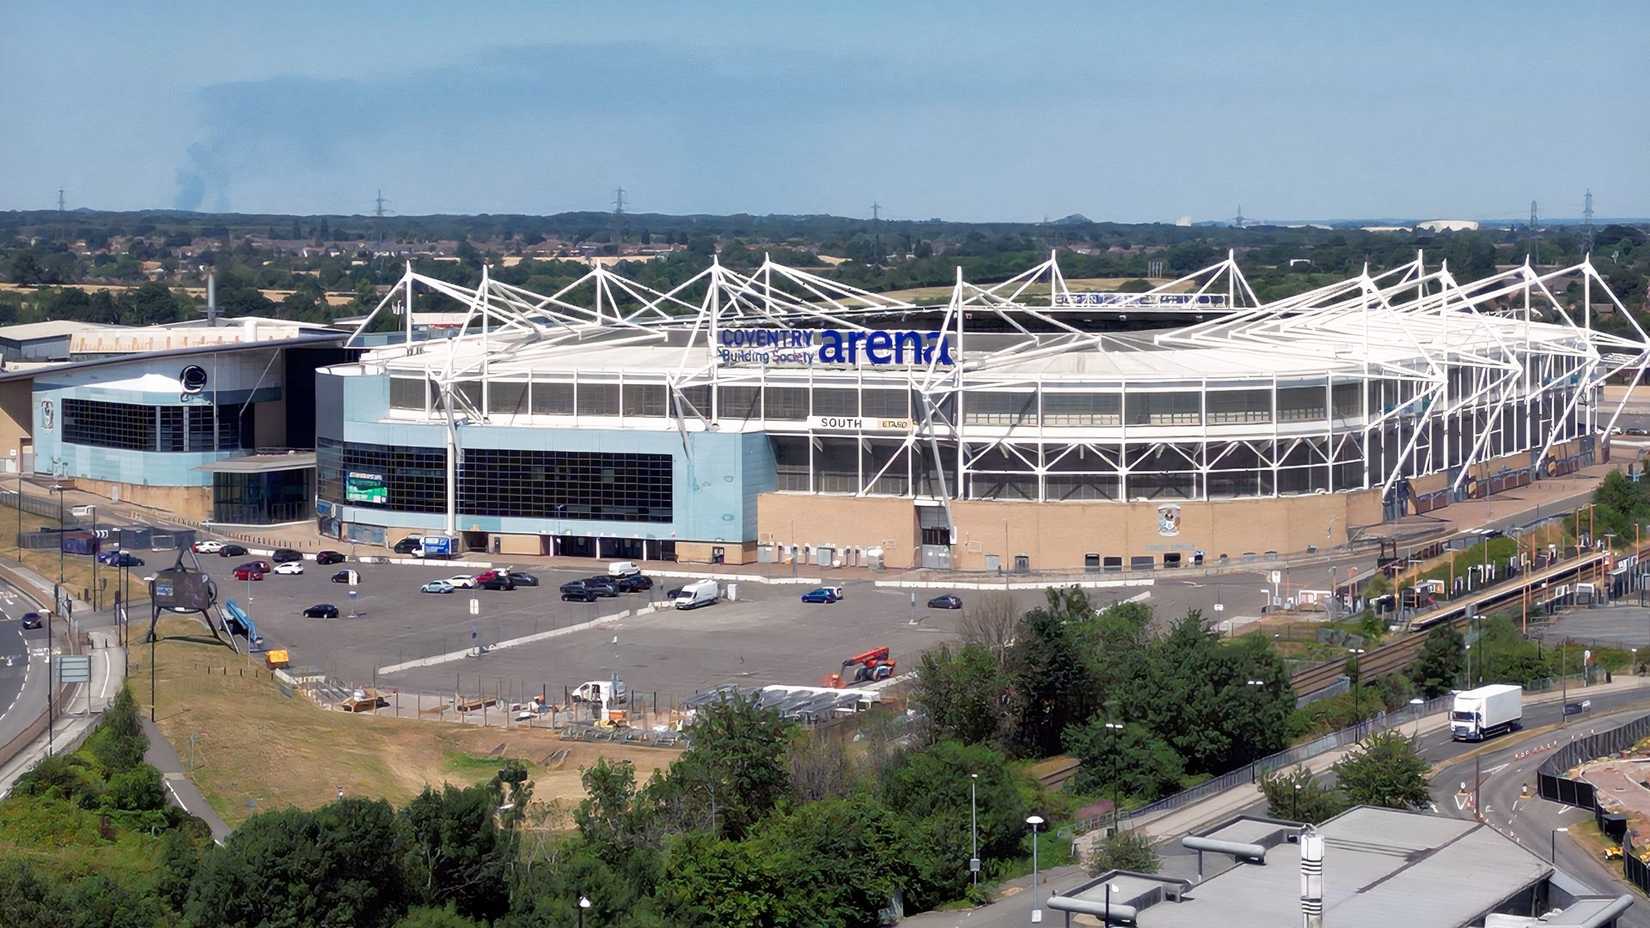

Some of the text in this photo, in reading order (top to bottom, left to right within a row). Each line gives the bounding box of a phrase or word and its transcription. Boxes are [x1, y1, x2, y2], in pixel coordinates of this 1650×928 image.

[722, 329, 814, 347] COVENTRY
[818, 330, 954, 365] arena
[722, 349, 815, 365] Building Society
[821, 418, 863, 428] SOUTH
